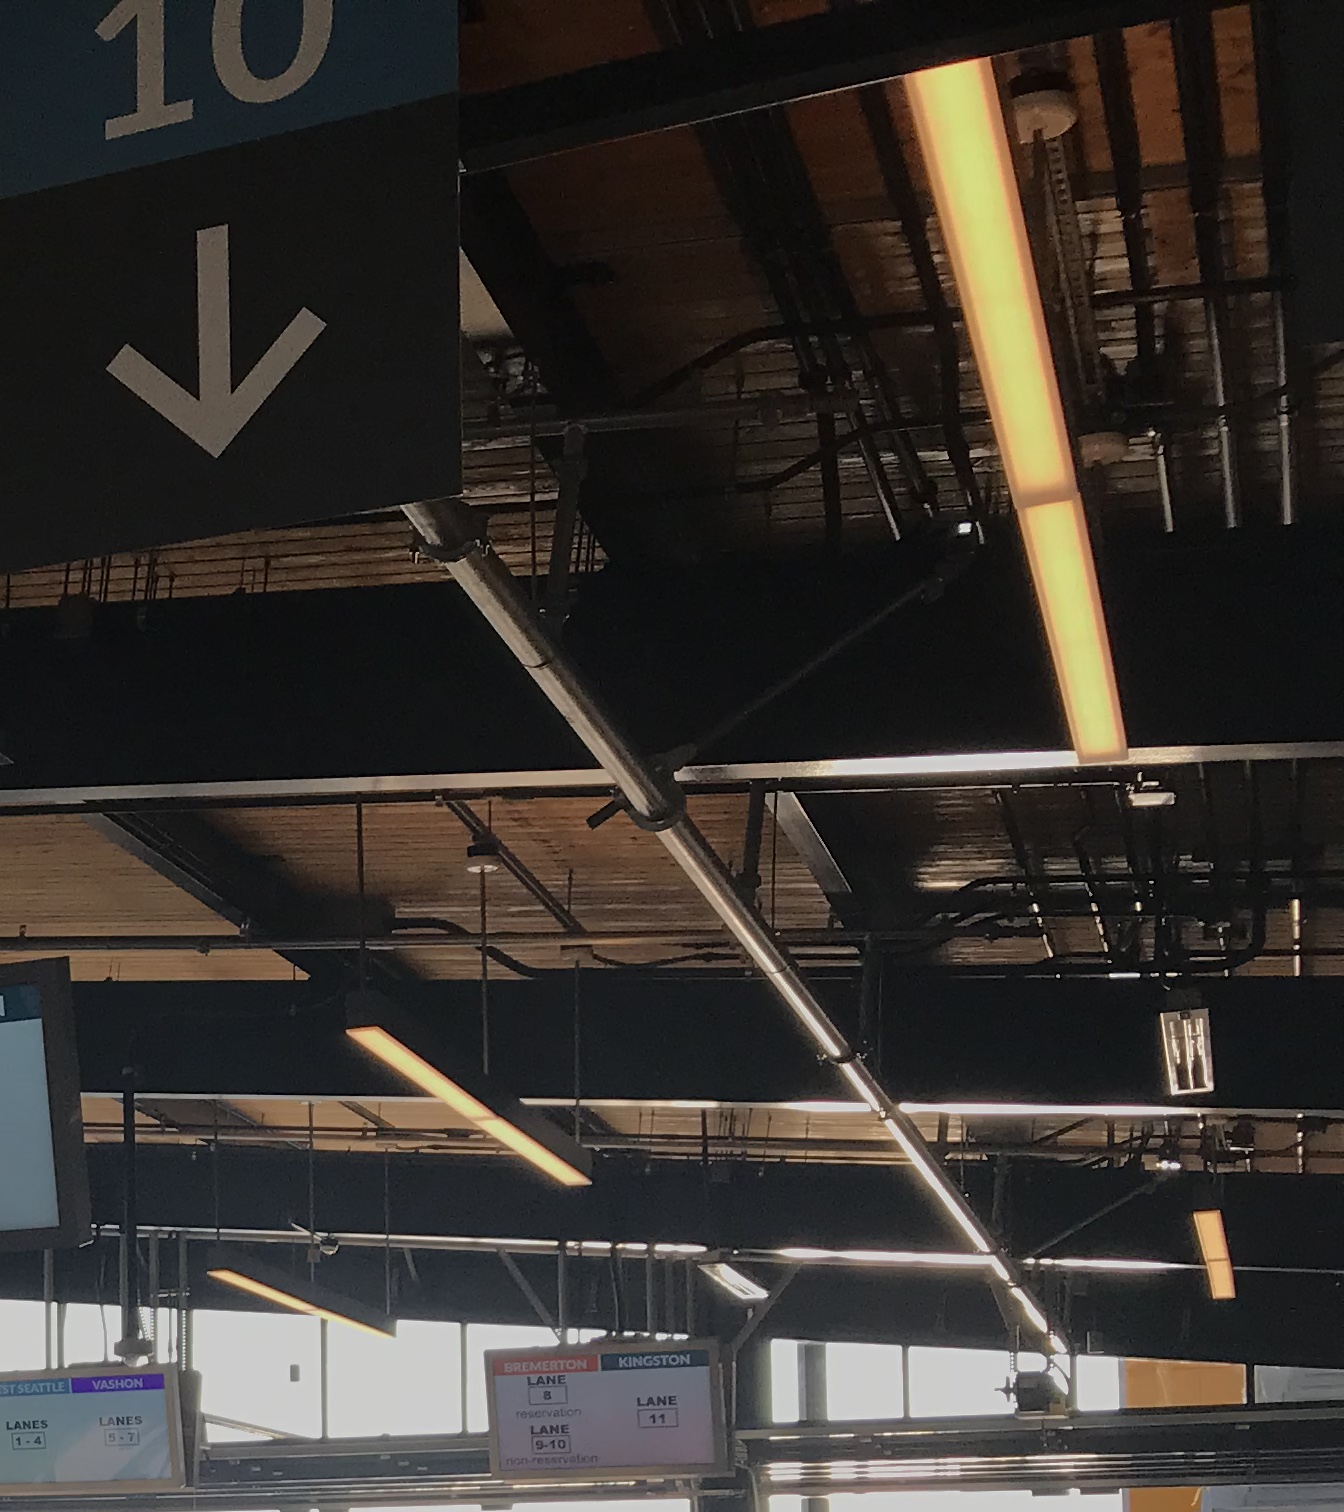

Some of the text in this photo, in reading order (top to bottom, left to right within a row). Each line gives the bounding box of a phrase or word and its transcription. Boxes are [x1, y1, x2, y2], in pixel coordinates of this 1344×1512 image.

[95, 0, 333, 141] 10
[503, 1359, 588, 1374] BREMERTON
[617, 1353, 691, 1368] KINGSTON
[91, 1377, 144, 1390] VASHON
[526, 1375, 566, 1386] LANE
[18, 1381, 66, 1394] SEATTLE
[637, 1395, 678, 1407] LANE
[515, 1407, 582, 1419] reservation
[649, 1413, 666, 1424] 11
[6, 1419, 48, 1431] LANES
[99, 1415, 143, 1427] LANES
[530, 1424, 570, 1435] LANE
[535, 1439, 566, 1450] 9-10
